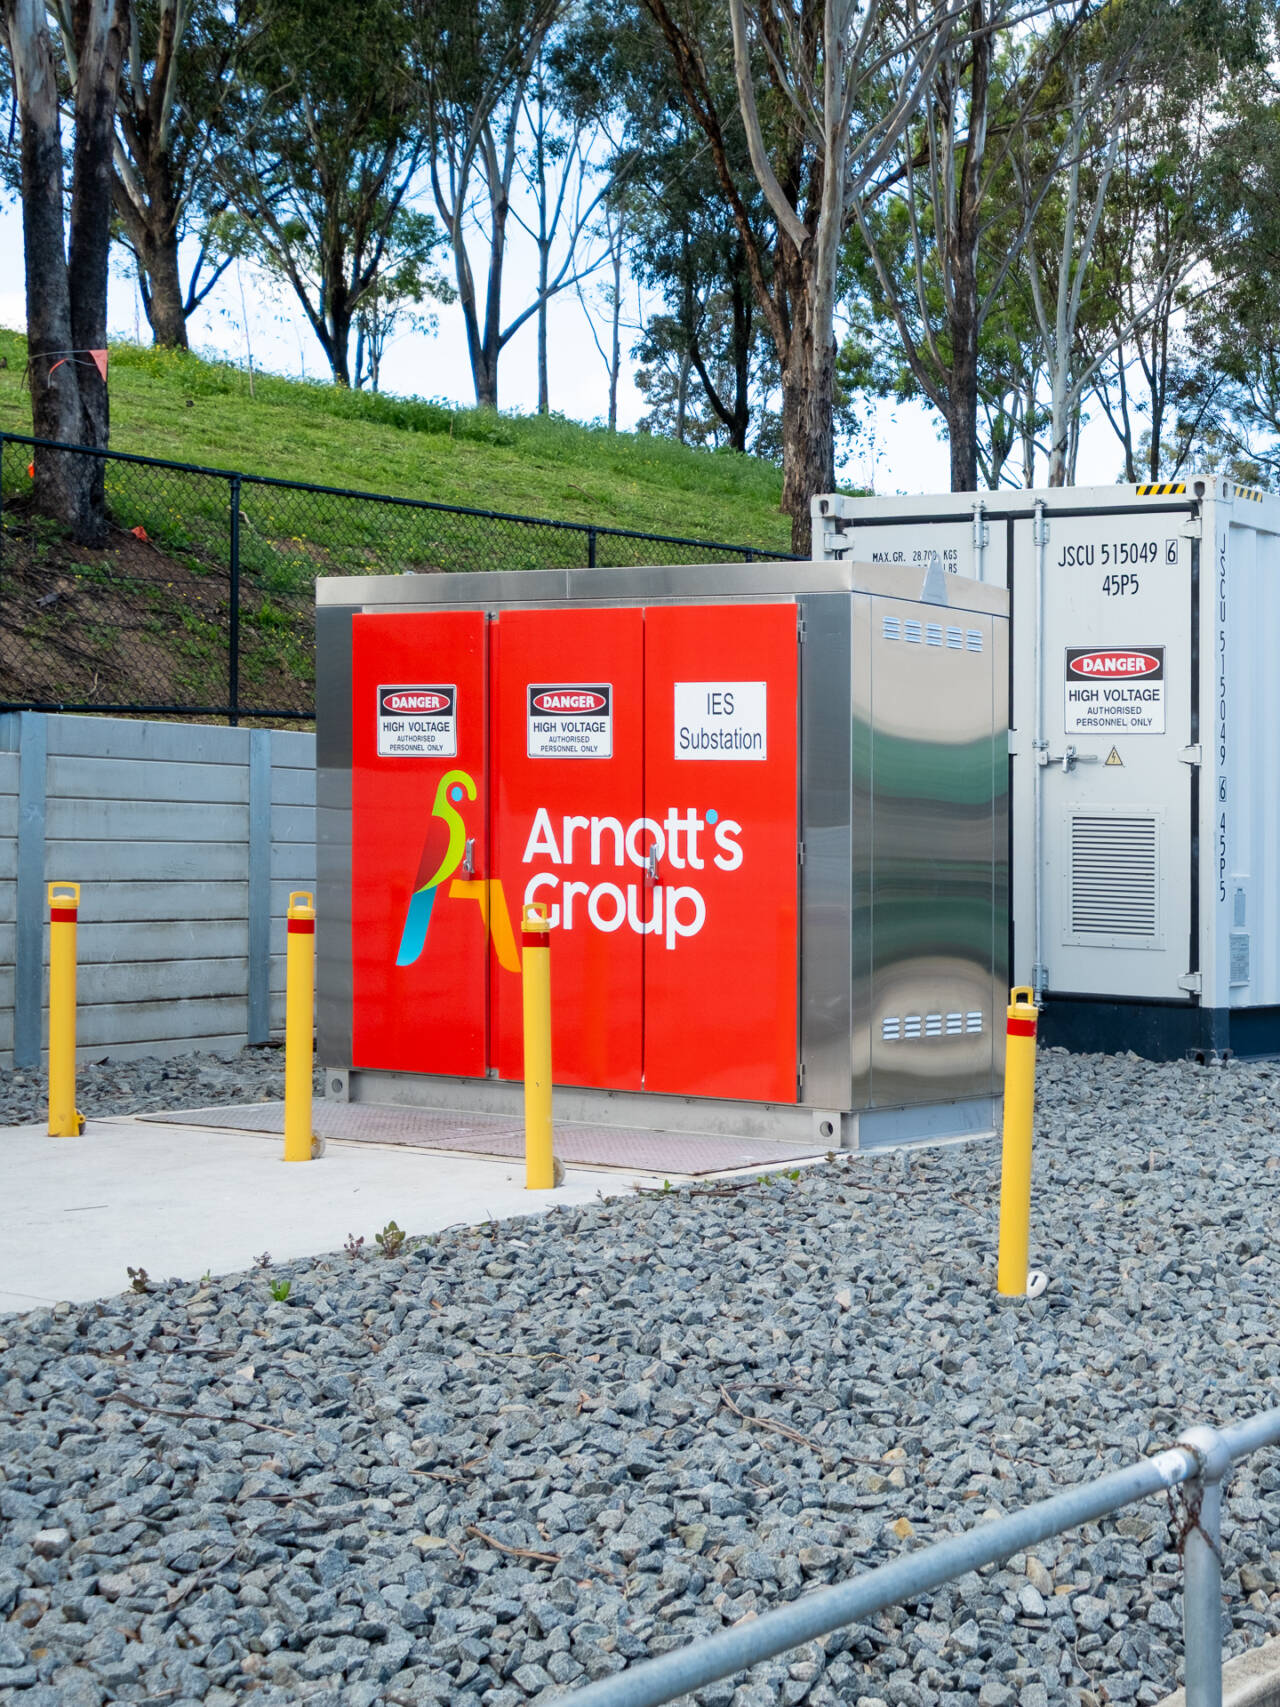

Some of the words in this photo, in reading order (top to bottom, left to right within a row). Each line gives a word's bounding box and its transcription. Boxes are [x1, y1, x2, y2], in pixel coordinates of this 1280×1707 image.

[943, 549, 958, 560] KGS
[1058, 544, 1095, 567] JSCU
[1101, 542, 1158, 565] 515049
[1167, 541, 1176, 563] 6
[1102, 574, 1139, 596] 45P5
[1082, 657, 1146, 672] DANGER
[543, 695, 595, 709] DANGER
[1069, 689, 1099, 702] HIGH
[1103, 689, 1160, 702] VOLTAGE
[391, 696, 440, 709] DANGER
[707, 692, 735, 716] IES
[1087, 706, 1142, 715] AUTHORISED
[383, 722, 405, 732] HIGH
[408, 722, 451, 732] VOLTAGE
[533, 722, 557, 733] HIGH
[561, 722, 606, 733] VOLTAGE
[1076, 718, 1127, 727] PERSONNEL
[1130, 718, 1153, 727] ONLY
[397, 735, 436, 743] AUTHORISED
[548, 735, 590, 743] AUTHORISED
[679, 727, 762, 750] Substation
[389, 744, 425, 752] PERSONNEL
[427, 744, 444, 752] ONLY
[540, 745, 578, 753] PERSONNEL
[581, 745, 598, 753] ONLY
[1219, 779, 1226, 800] 6
[522, 807, 744, 872] Arnott's
[523, 872, 706, 951] Group
